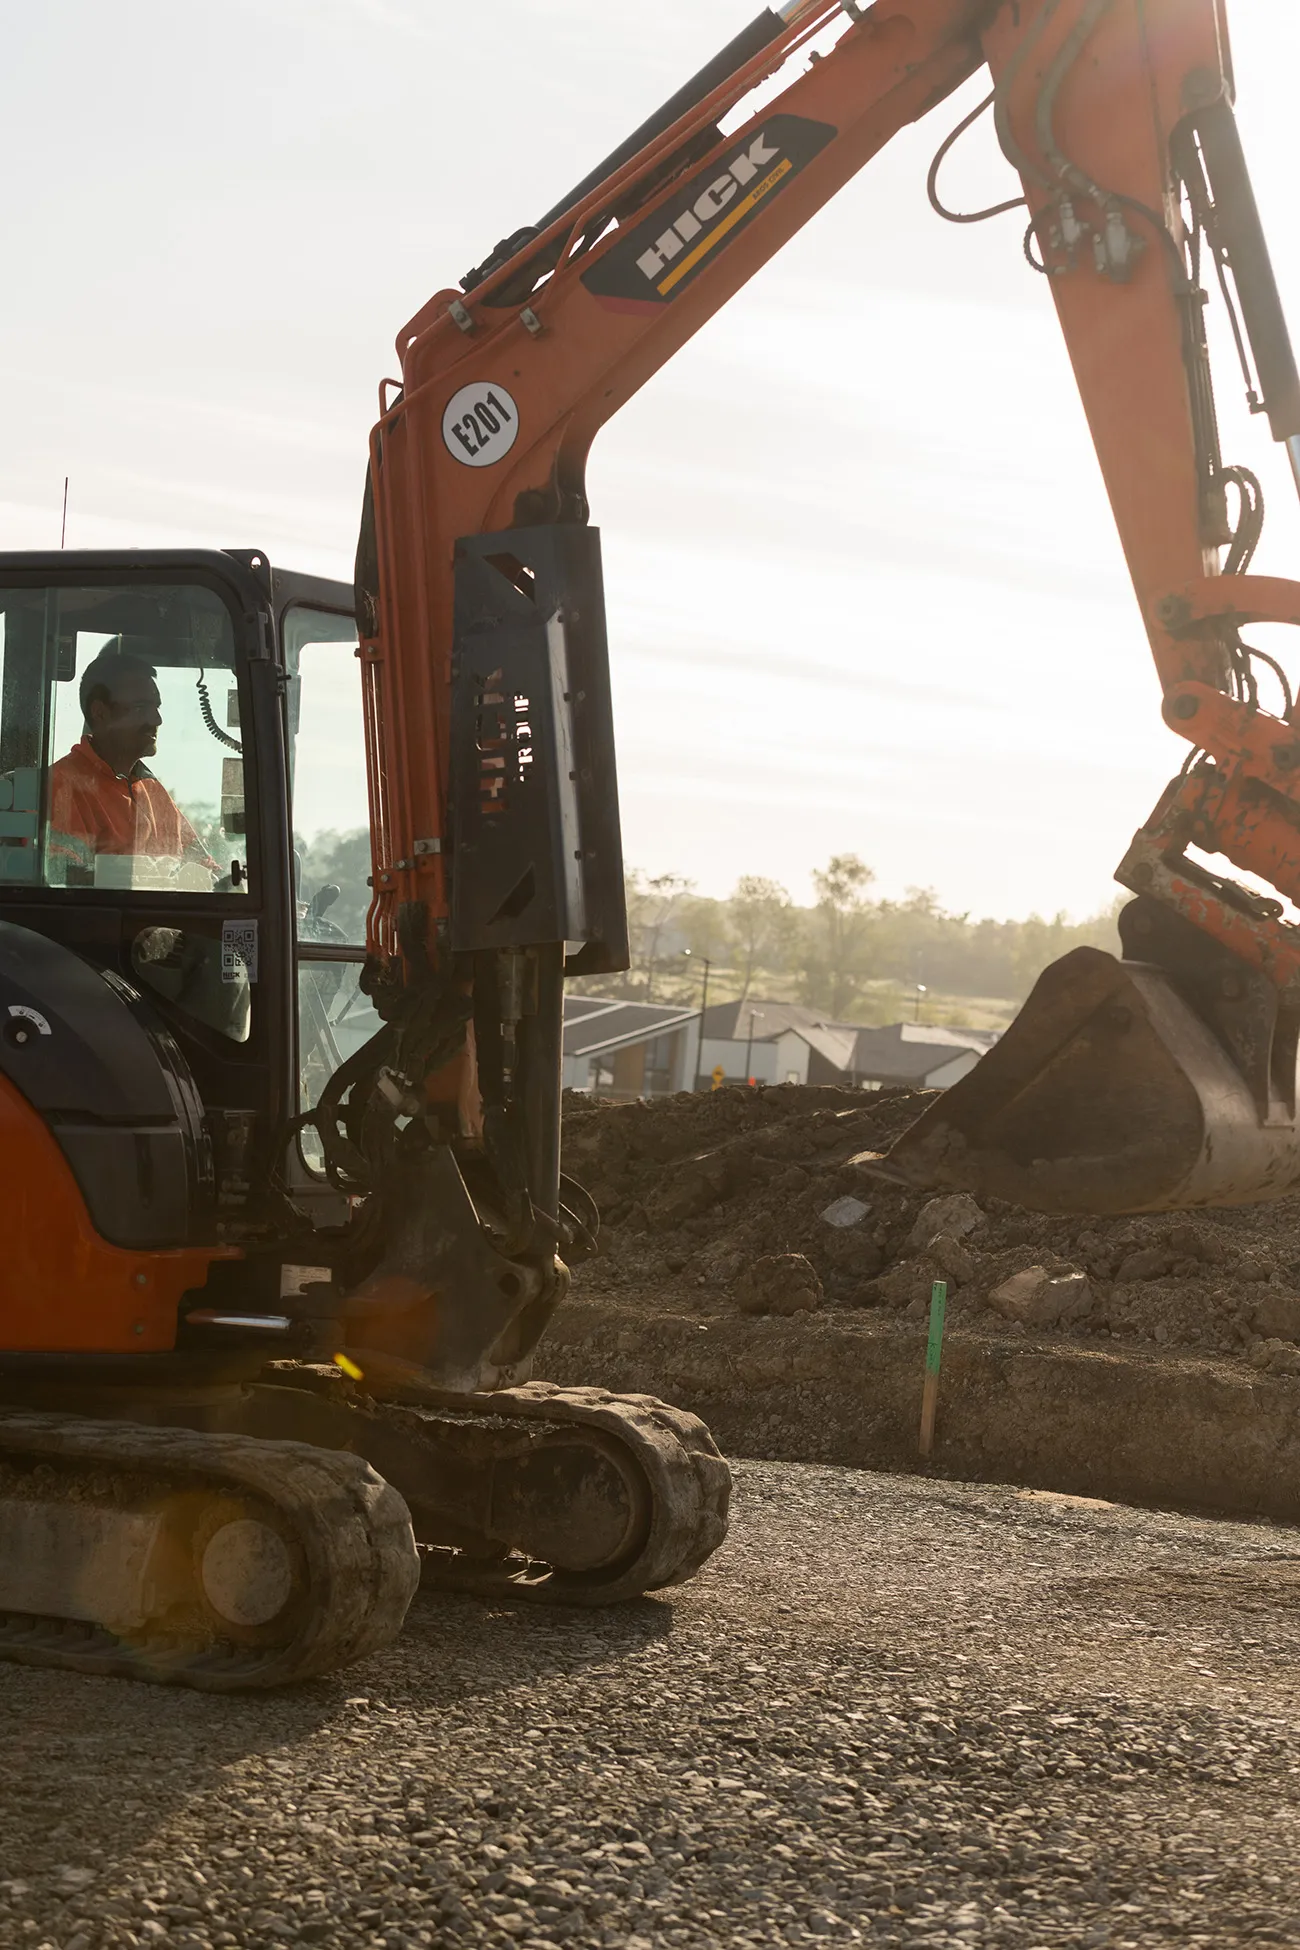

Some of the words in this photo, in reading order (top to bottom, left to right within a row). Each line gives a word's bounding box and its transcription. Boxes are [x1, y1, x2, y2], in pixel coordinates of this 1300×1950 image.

[635, 132, 780, 280] HICK
[451, 391, 512, 457] E201
[473, 667, 508, 814] HICK
